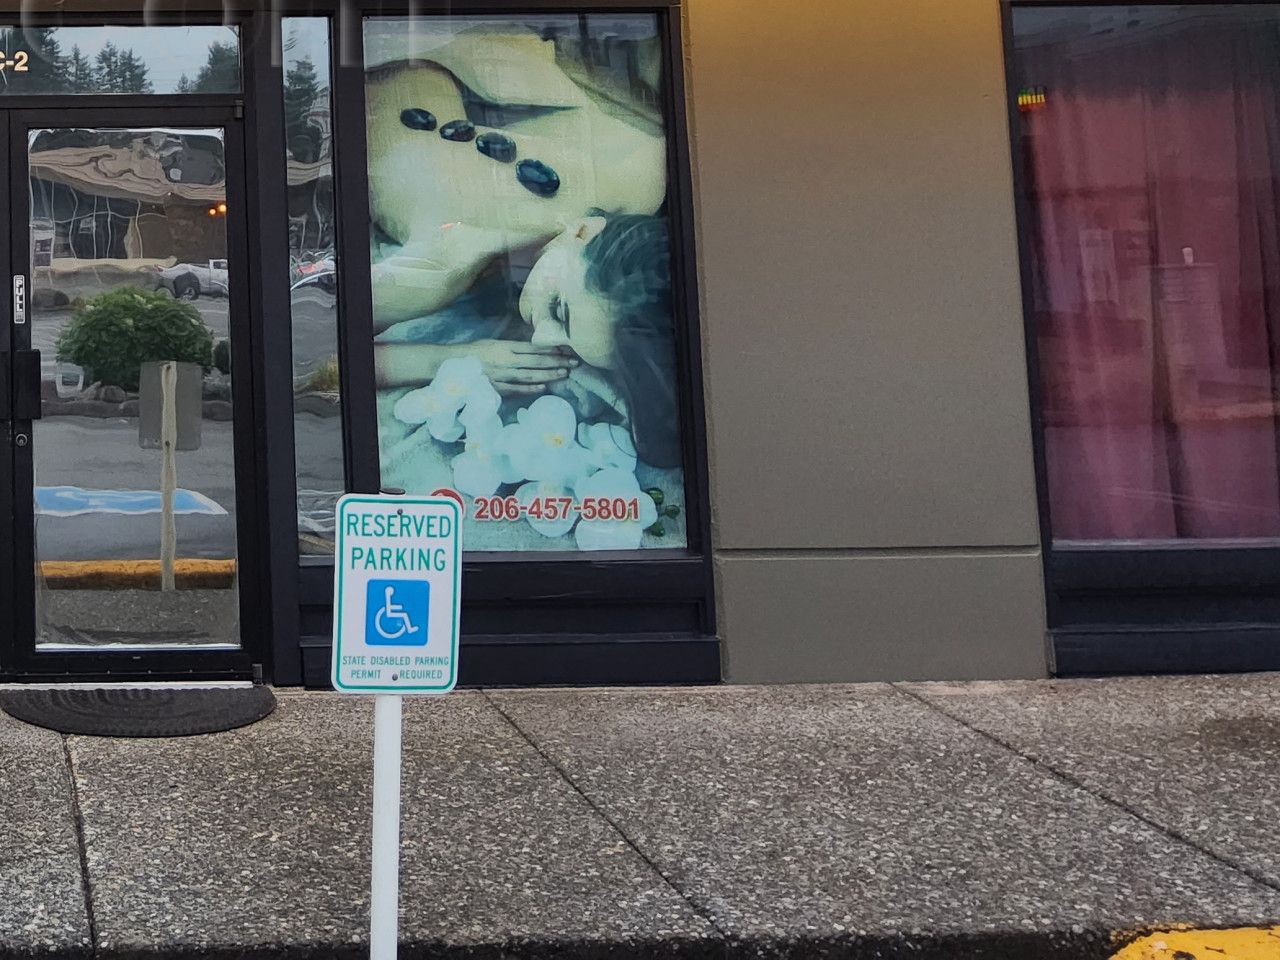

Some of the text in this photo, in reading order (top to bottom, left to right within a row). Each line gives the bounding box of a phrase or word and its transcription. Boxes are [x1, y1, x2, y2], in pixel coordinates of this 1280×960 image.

[15, 280, 23, 312] PULL
[474, 497, 640, 520] 206-457-5801
[347, 513, 451, 538] RESERVED
[351, 547, 446, 571] PARKING
[342, 656, 449, 665] STATE DISABLED PARKING
[351, 670, 442, 679] PERMIT REQUIRED
